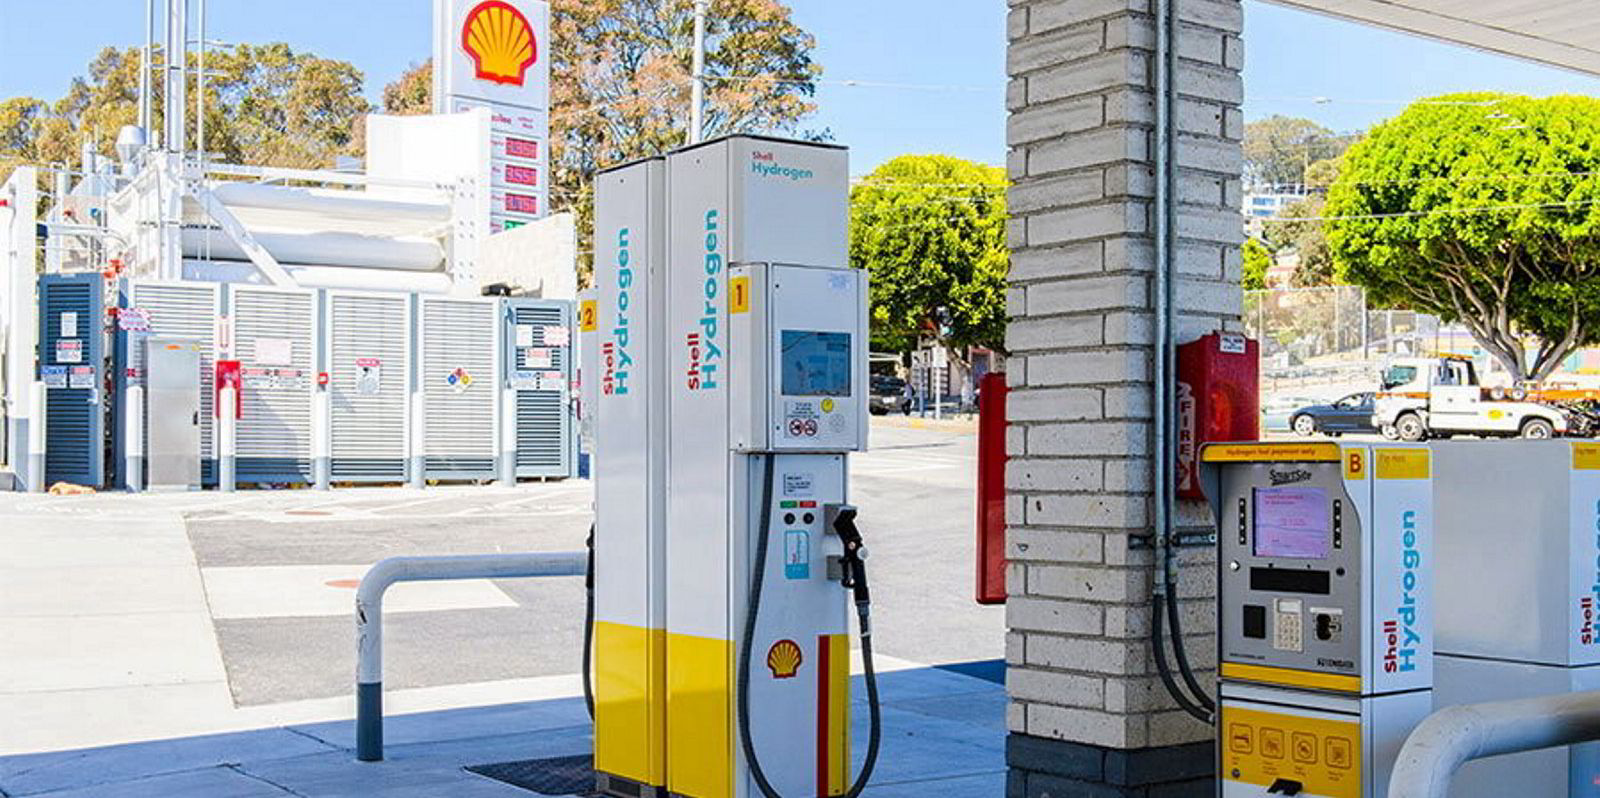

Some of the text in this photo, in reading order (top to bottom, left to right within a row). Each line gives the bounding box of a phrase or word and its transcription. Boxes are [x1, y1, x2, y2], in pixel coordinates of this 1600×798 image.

[752, 151, 774, 161] Shell
[752, 162, 813, 181] Hydrogen
[585, 308, 593, 325] 2
[613, 228, 632, 395] Hydrogen
[700, 209, 722, 389] Hydrogen
[736, 283, 743, 306] 1
[603, 343, 613, 395] Shell
[687, 333, 699, 390] Shell
[1180, 401, 1191, 455] FIRE
[1350, 454, 1361, 472] B
[1398, 511, 1421, 672] Hydrogen
[1384, 621, 1397, 673] Shell
[1582, 598, 1592, 644] Shell
